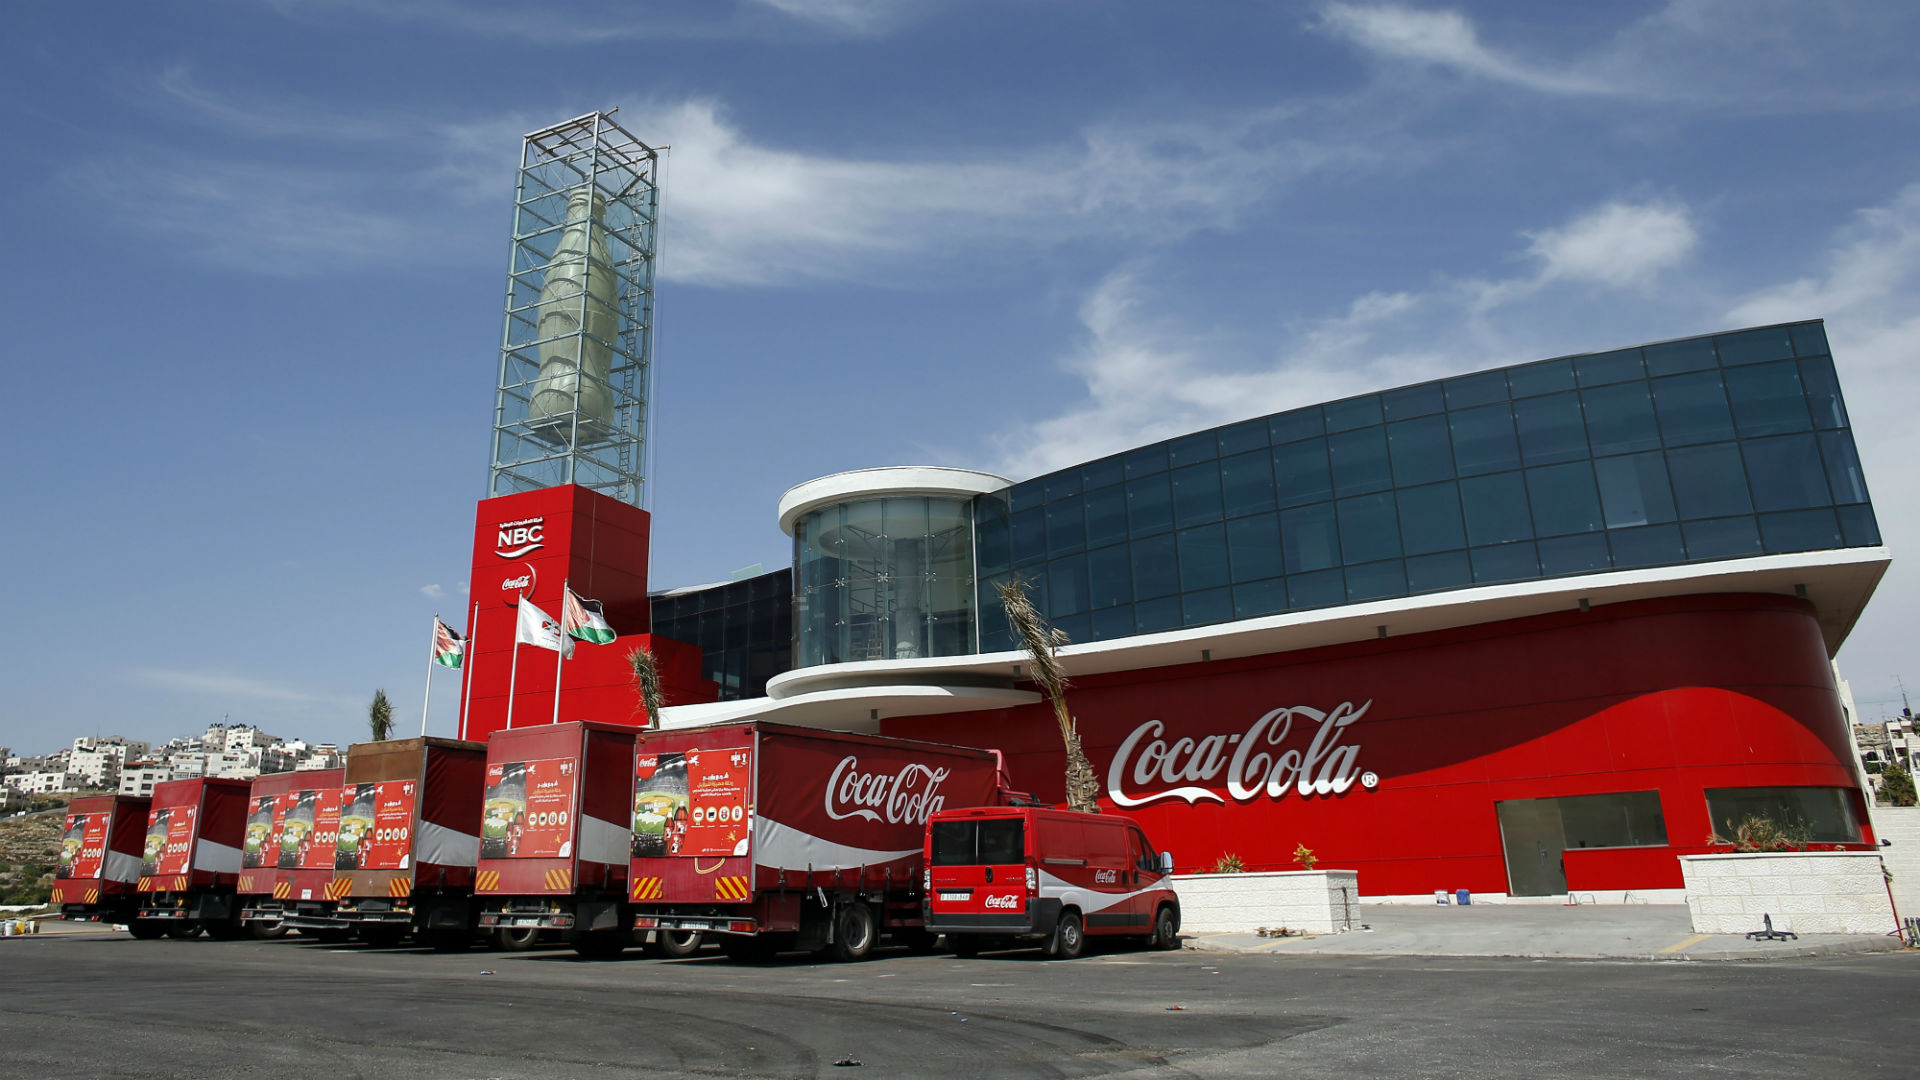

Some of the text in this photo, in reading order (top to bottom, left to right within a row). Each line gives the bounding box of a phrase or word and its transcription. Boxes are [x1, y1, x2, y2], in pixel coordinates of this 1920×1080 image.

[498, 525, 544, 547] NBC
[1107, 698, 1373, 807] Coca-Cola
[825, 755, 951, 825] Coca-Cola
